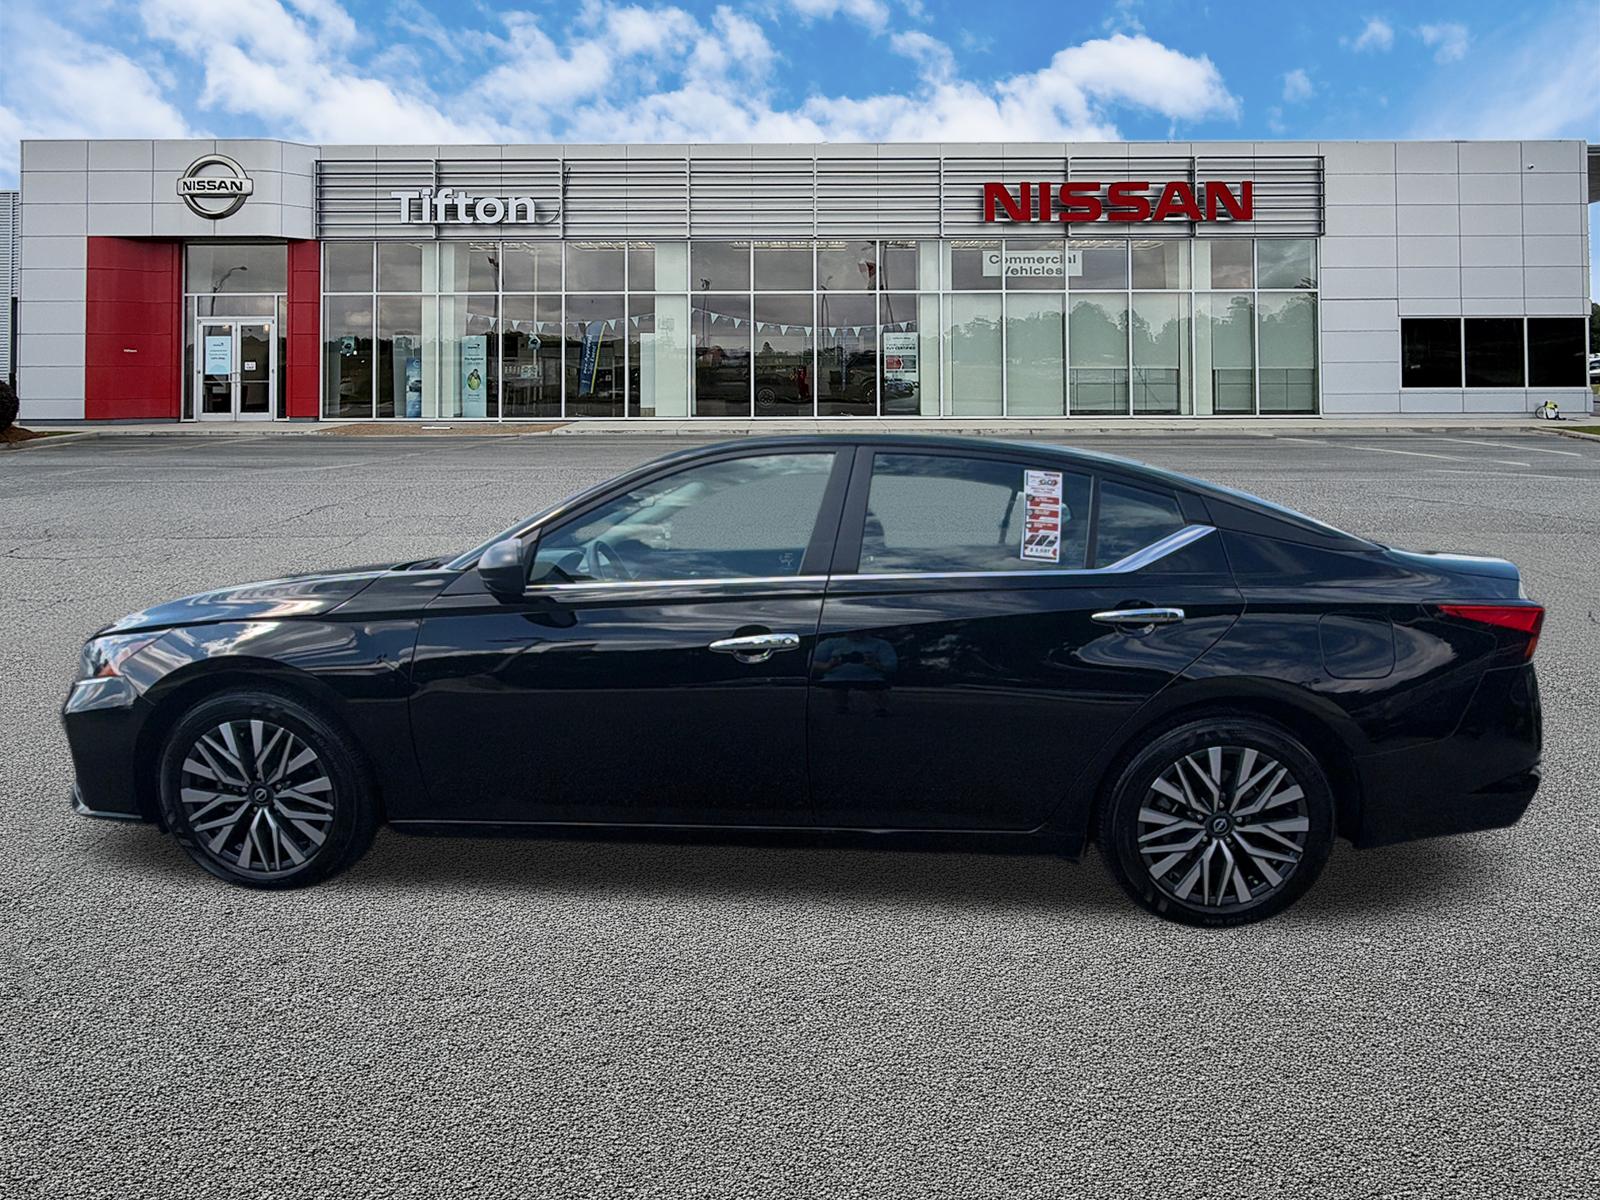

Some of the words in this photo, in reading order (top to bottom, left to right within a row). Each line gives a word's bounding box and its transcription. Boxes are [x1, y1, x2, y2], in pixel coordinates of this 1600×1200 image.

[183, 180, 243, 192] NISSAN
[983, 181, 1254, 222] NISSAN
[390, 188, 536, 224] Tifton
